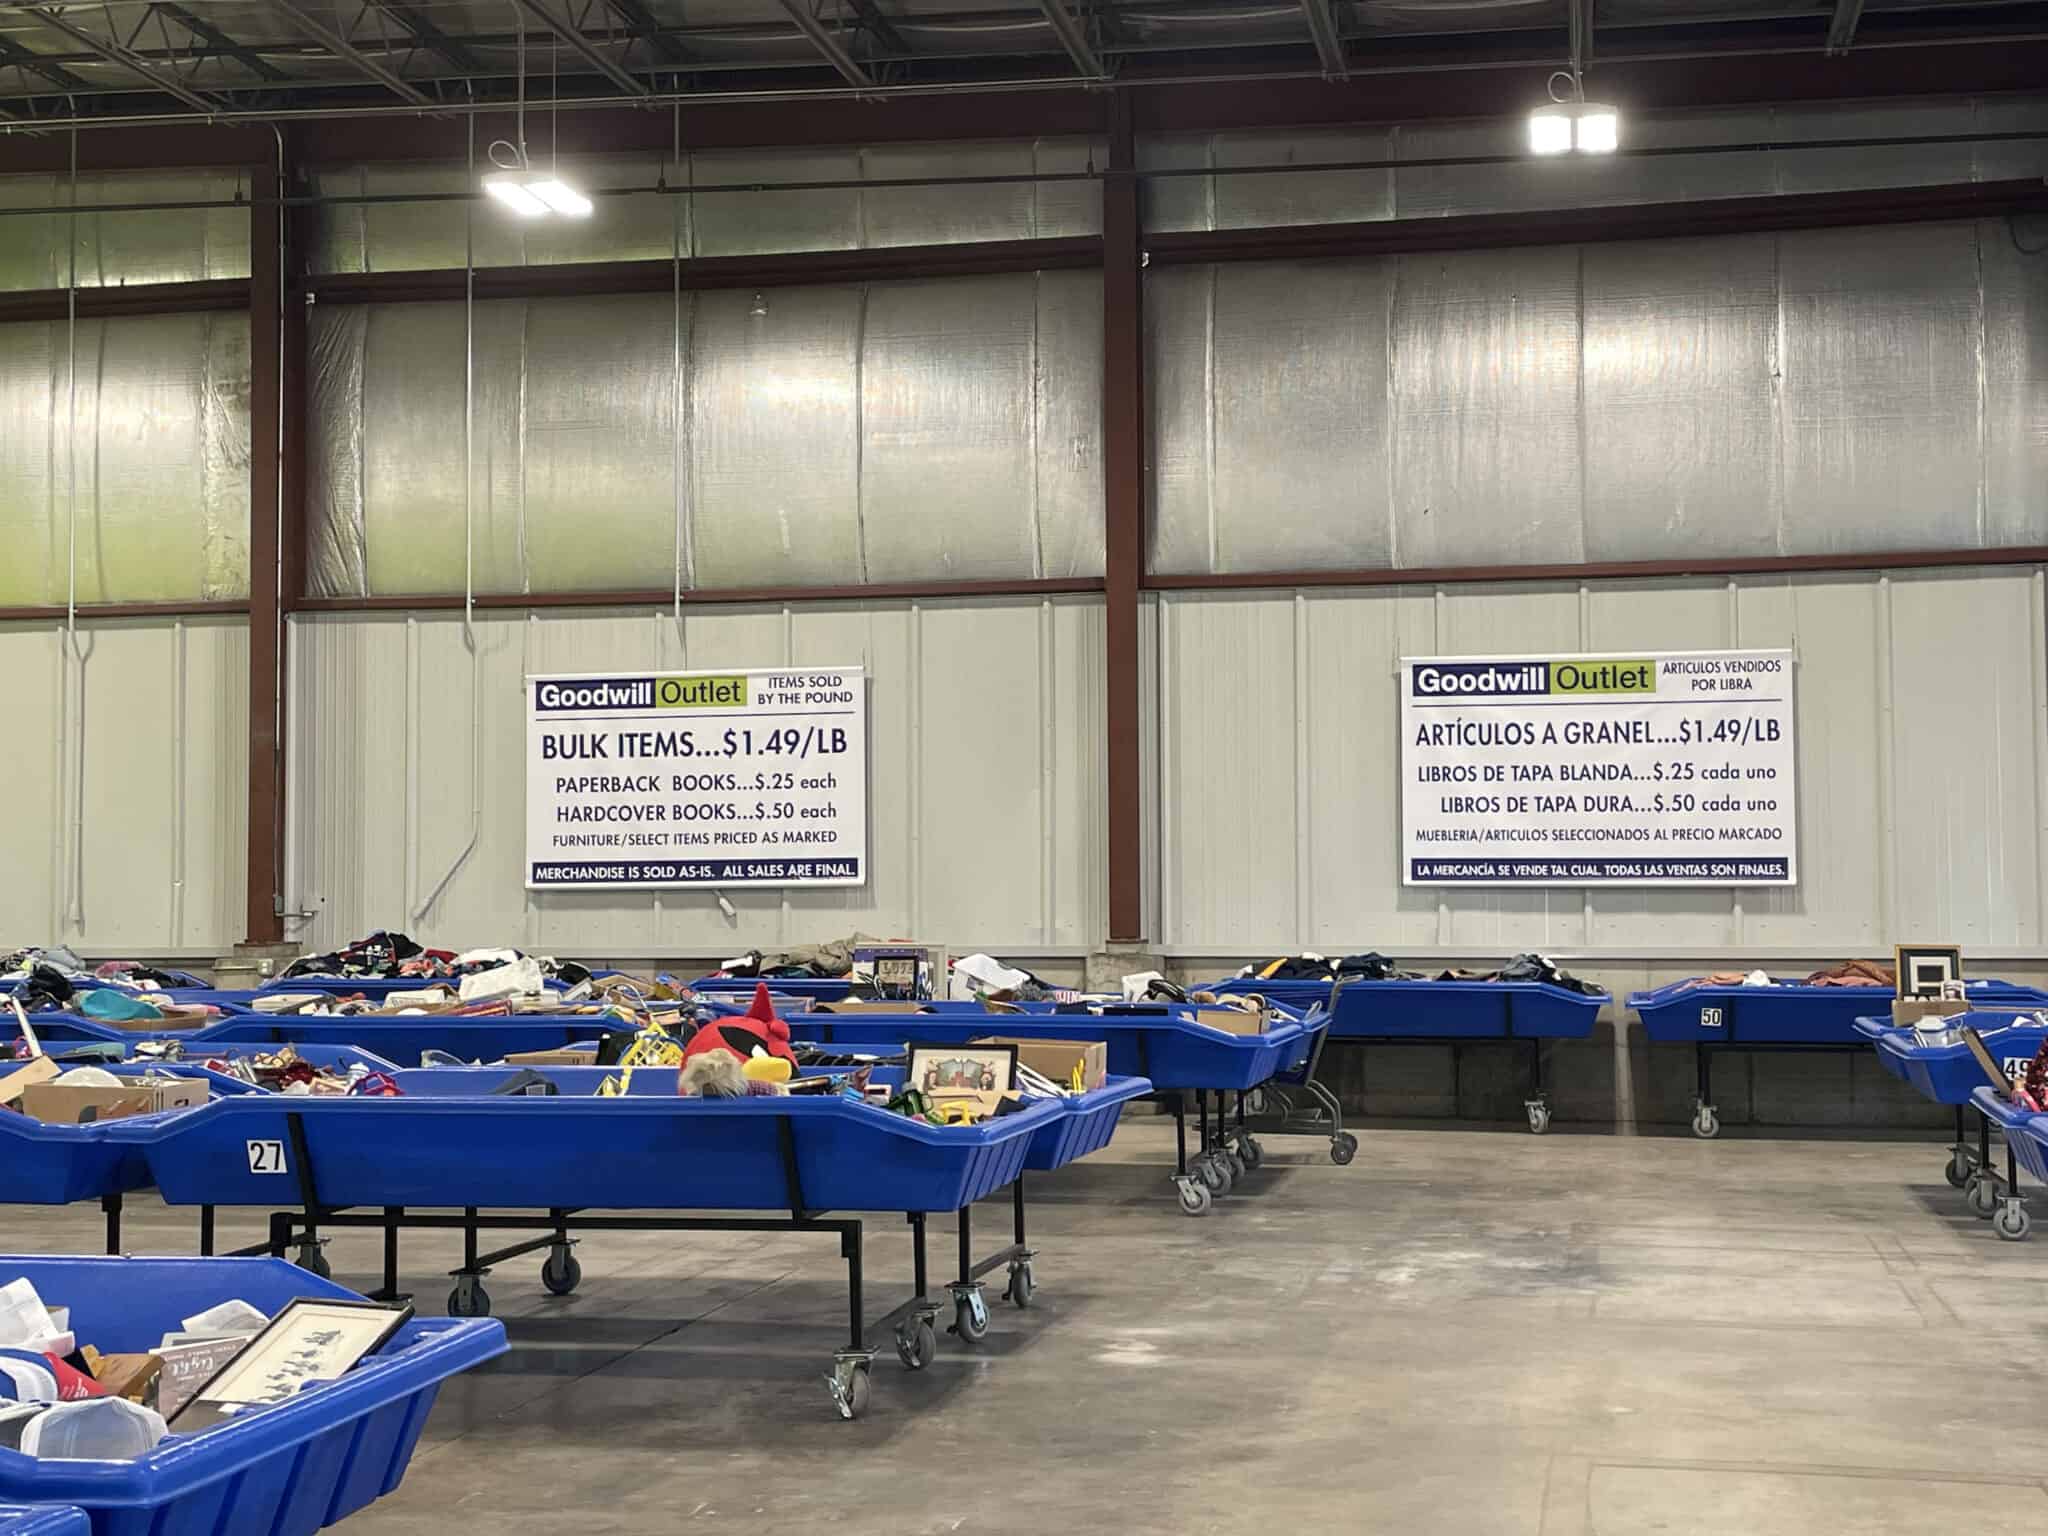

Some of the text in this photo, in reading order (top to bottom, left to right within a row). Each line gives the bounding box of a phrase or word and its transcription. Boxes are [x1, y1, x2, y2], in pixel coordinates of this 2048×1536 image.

[1663, 660, 1781, 674] ARTICULOS VENDIDOS
[768, 676, 842, 688] ITEMS SOLD
[1418, 665, 1649, 693] Goodwill Outlet
[1692, 677, 1752, 691] POR LIBRA
[540, 680, 741, 708] Goodwill Outlet
[758, 691, 853, 705] BY THE POUND
[1415, 717, 1781, 746] ARTÍCULOS A GRANEL...$1.49/LB
[542, 727, 847, 760] BULK ITEMS...$1.49/LB
[1418, 762, 1777, 783] LIBROS DE TAPA BLANDA...$.25 cada uno
[556, 772, 837, 793] PAPERBACK BOOKS...$.25 each
[557, 801, 837, 823] HARDCOVER BOOKS...$.50 each
[1441, 793, 1777, 814] LIBROS DE TAPA DURA...$.50 cada uno
[553, 830, 838, 848] FURNITURE/SELECT ITEMS PRICED AS MARKED
[1416, 827, 1783, 843] MUEBLERIA/ARTICULOS SELECCIONADOS AL PRECIO MARCADO
[536, 863, 856, 879] MERCHANDISE IS SOLD AS-IS. ALL SALES ARE FINAL.
[1417, 864, 1430, 876] LA
[1432, 862, 1496, 876] MERCANCÍA
[1497, 864, 1510, 876] SE
[1512, 864, 1549, 876] VENDE
[1551, 864, 1569, 876] TAL
[1604, 864, 1641, 876] TODAS
[1644, 864, 1665, 876] LAS
[1666, 863, 1708, 876] VENTAS
[1711, 863, 1736, 876] SON
[1738, 863, 1785, 876] FINALES.
[1703, 1009, 1721, 1024] 50
[250, 1143, 280, 1170] 27
